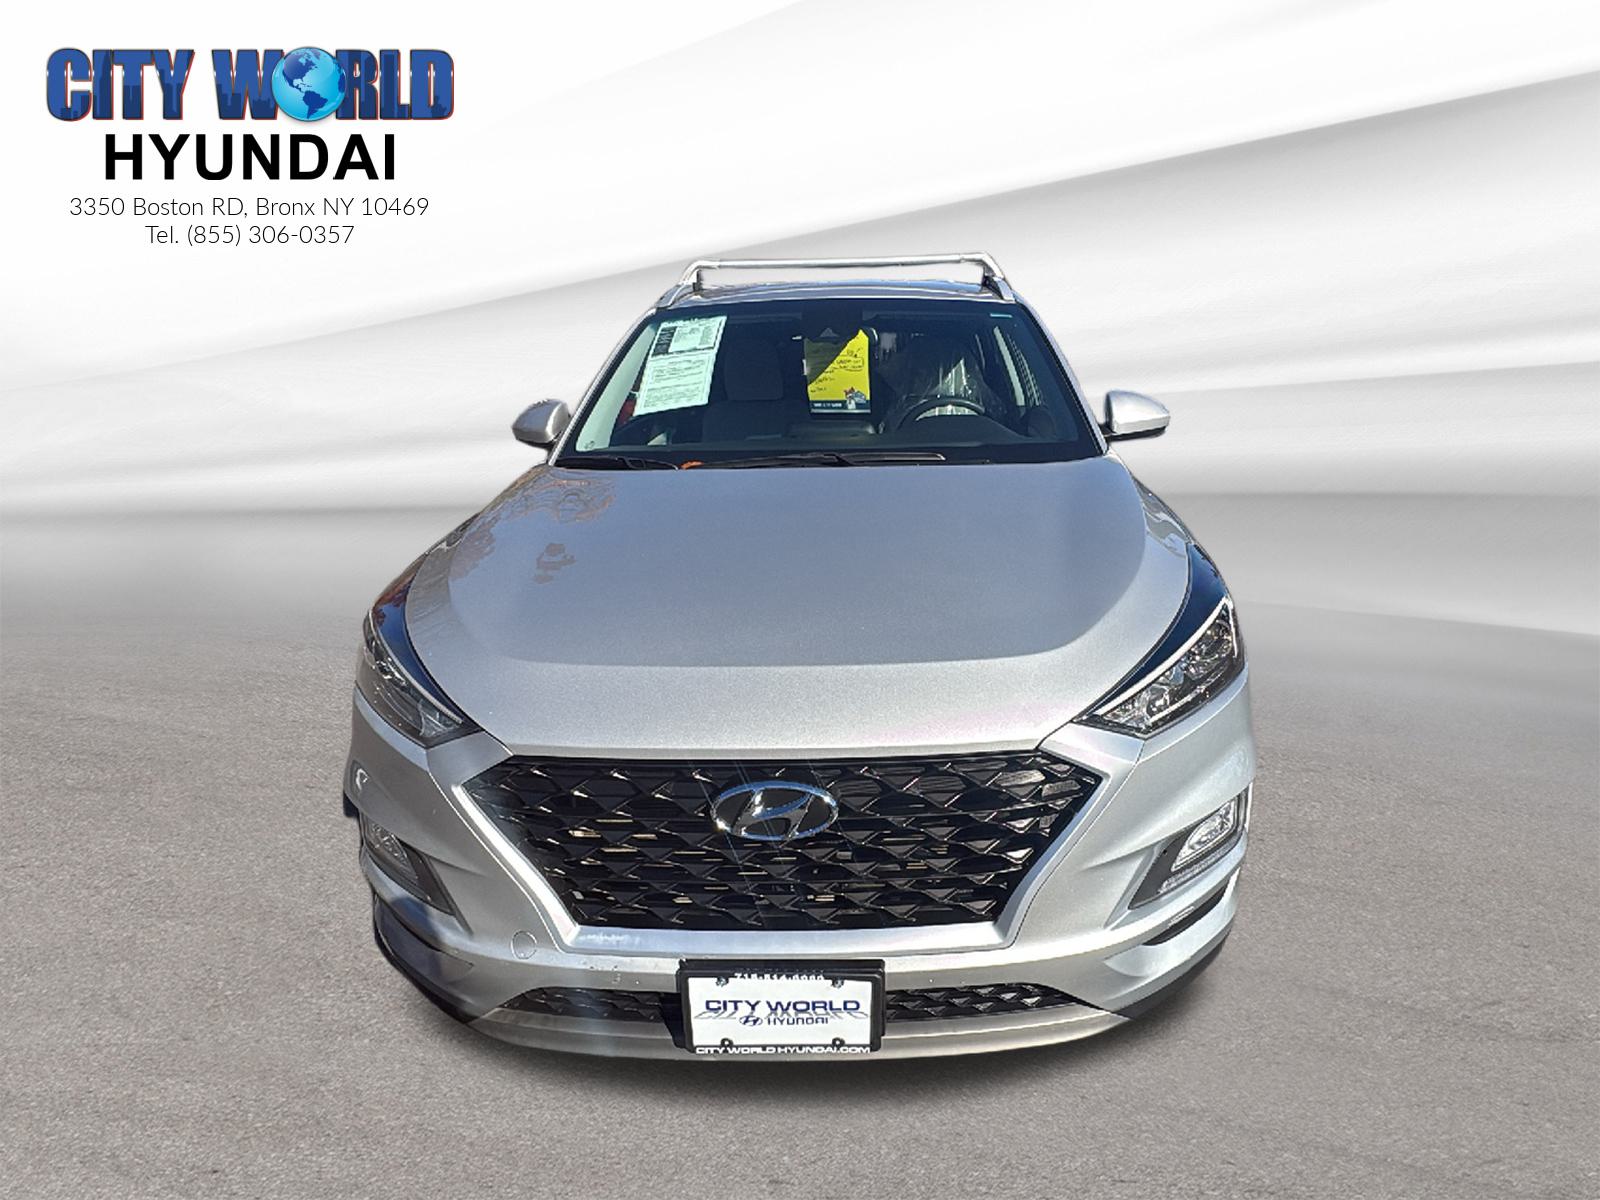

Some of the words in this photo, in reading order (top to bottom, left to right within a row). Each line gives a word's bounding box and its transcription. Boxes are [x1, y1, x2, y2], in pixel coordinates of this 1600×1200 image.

[705, 1000, 761, 1013] CITY
[765, 1000, 860, 1013] WORLD
[767, 1017, 829, 1026] HYUNDAI
[695, 1046, 725, 1055] CITY
[727, 1046, 776, 1055] WORLD
